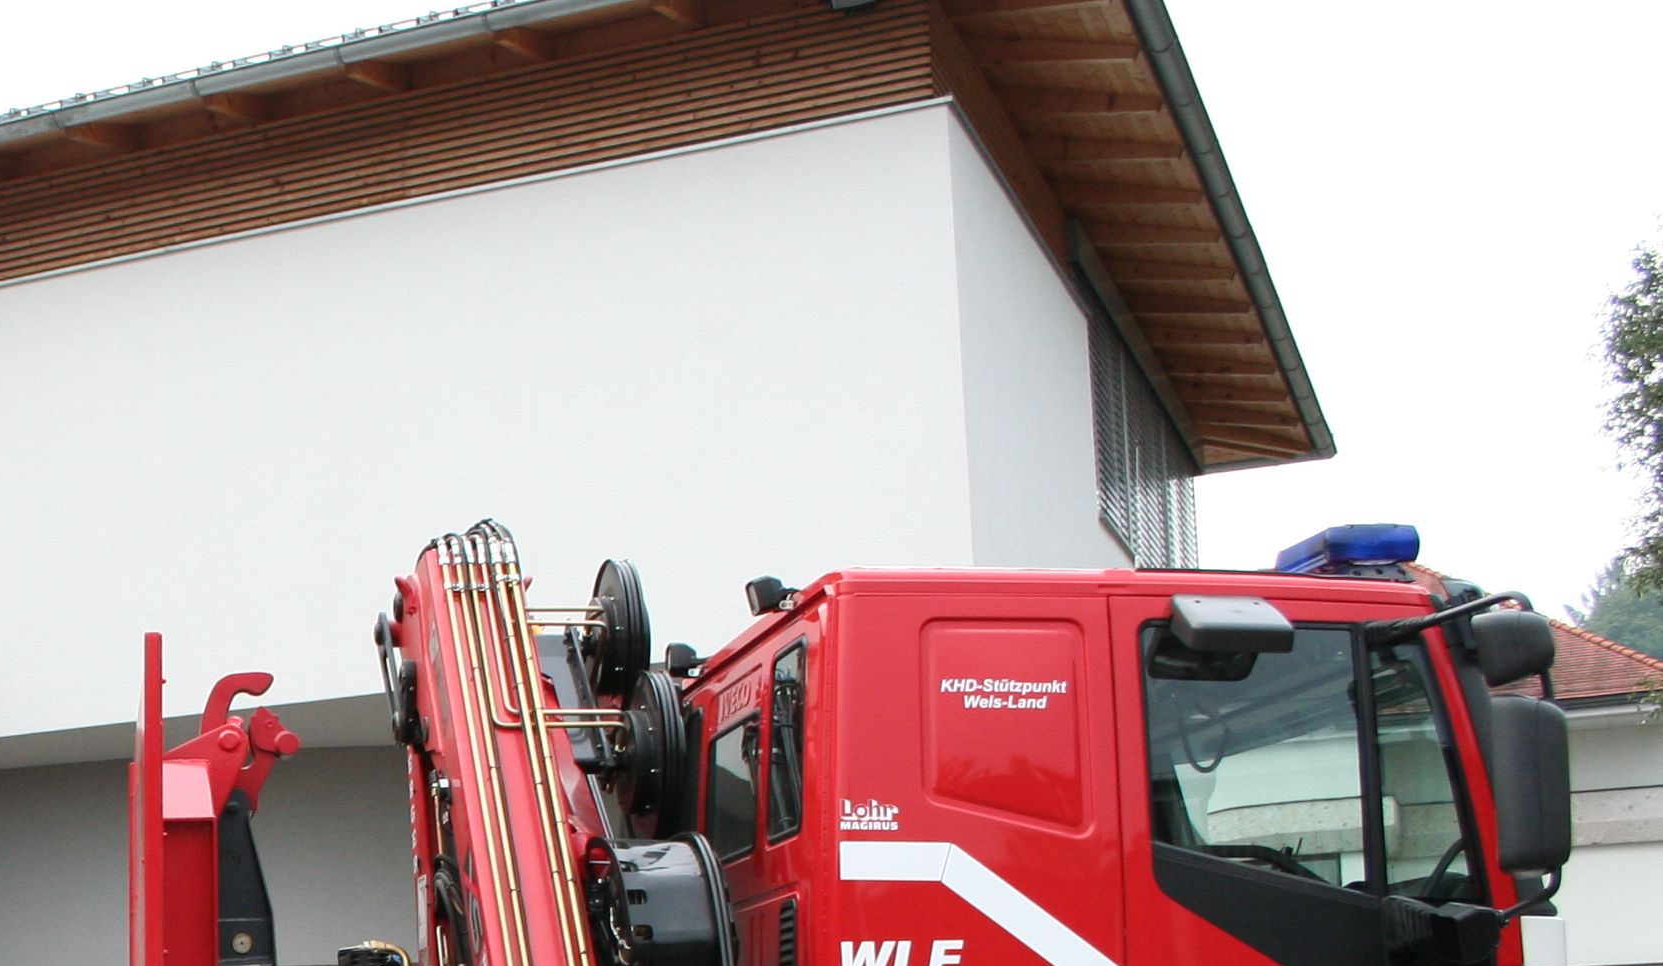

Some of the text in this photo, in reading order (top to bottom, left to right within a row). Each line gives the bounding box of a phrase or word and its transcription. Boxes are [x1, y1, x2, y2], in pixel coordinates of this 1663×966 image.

[940, 678, 1067, 697] KHD-Stützpunkt
[963, 694, 1047, 710] Wels-Land
[839, 799, 899, 821] Lohr
[839, 821, 899, 831] MAGIRUS
